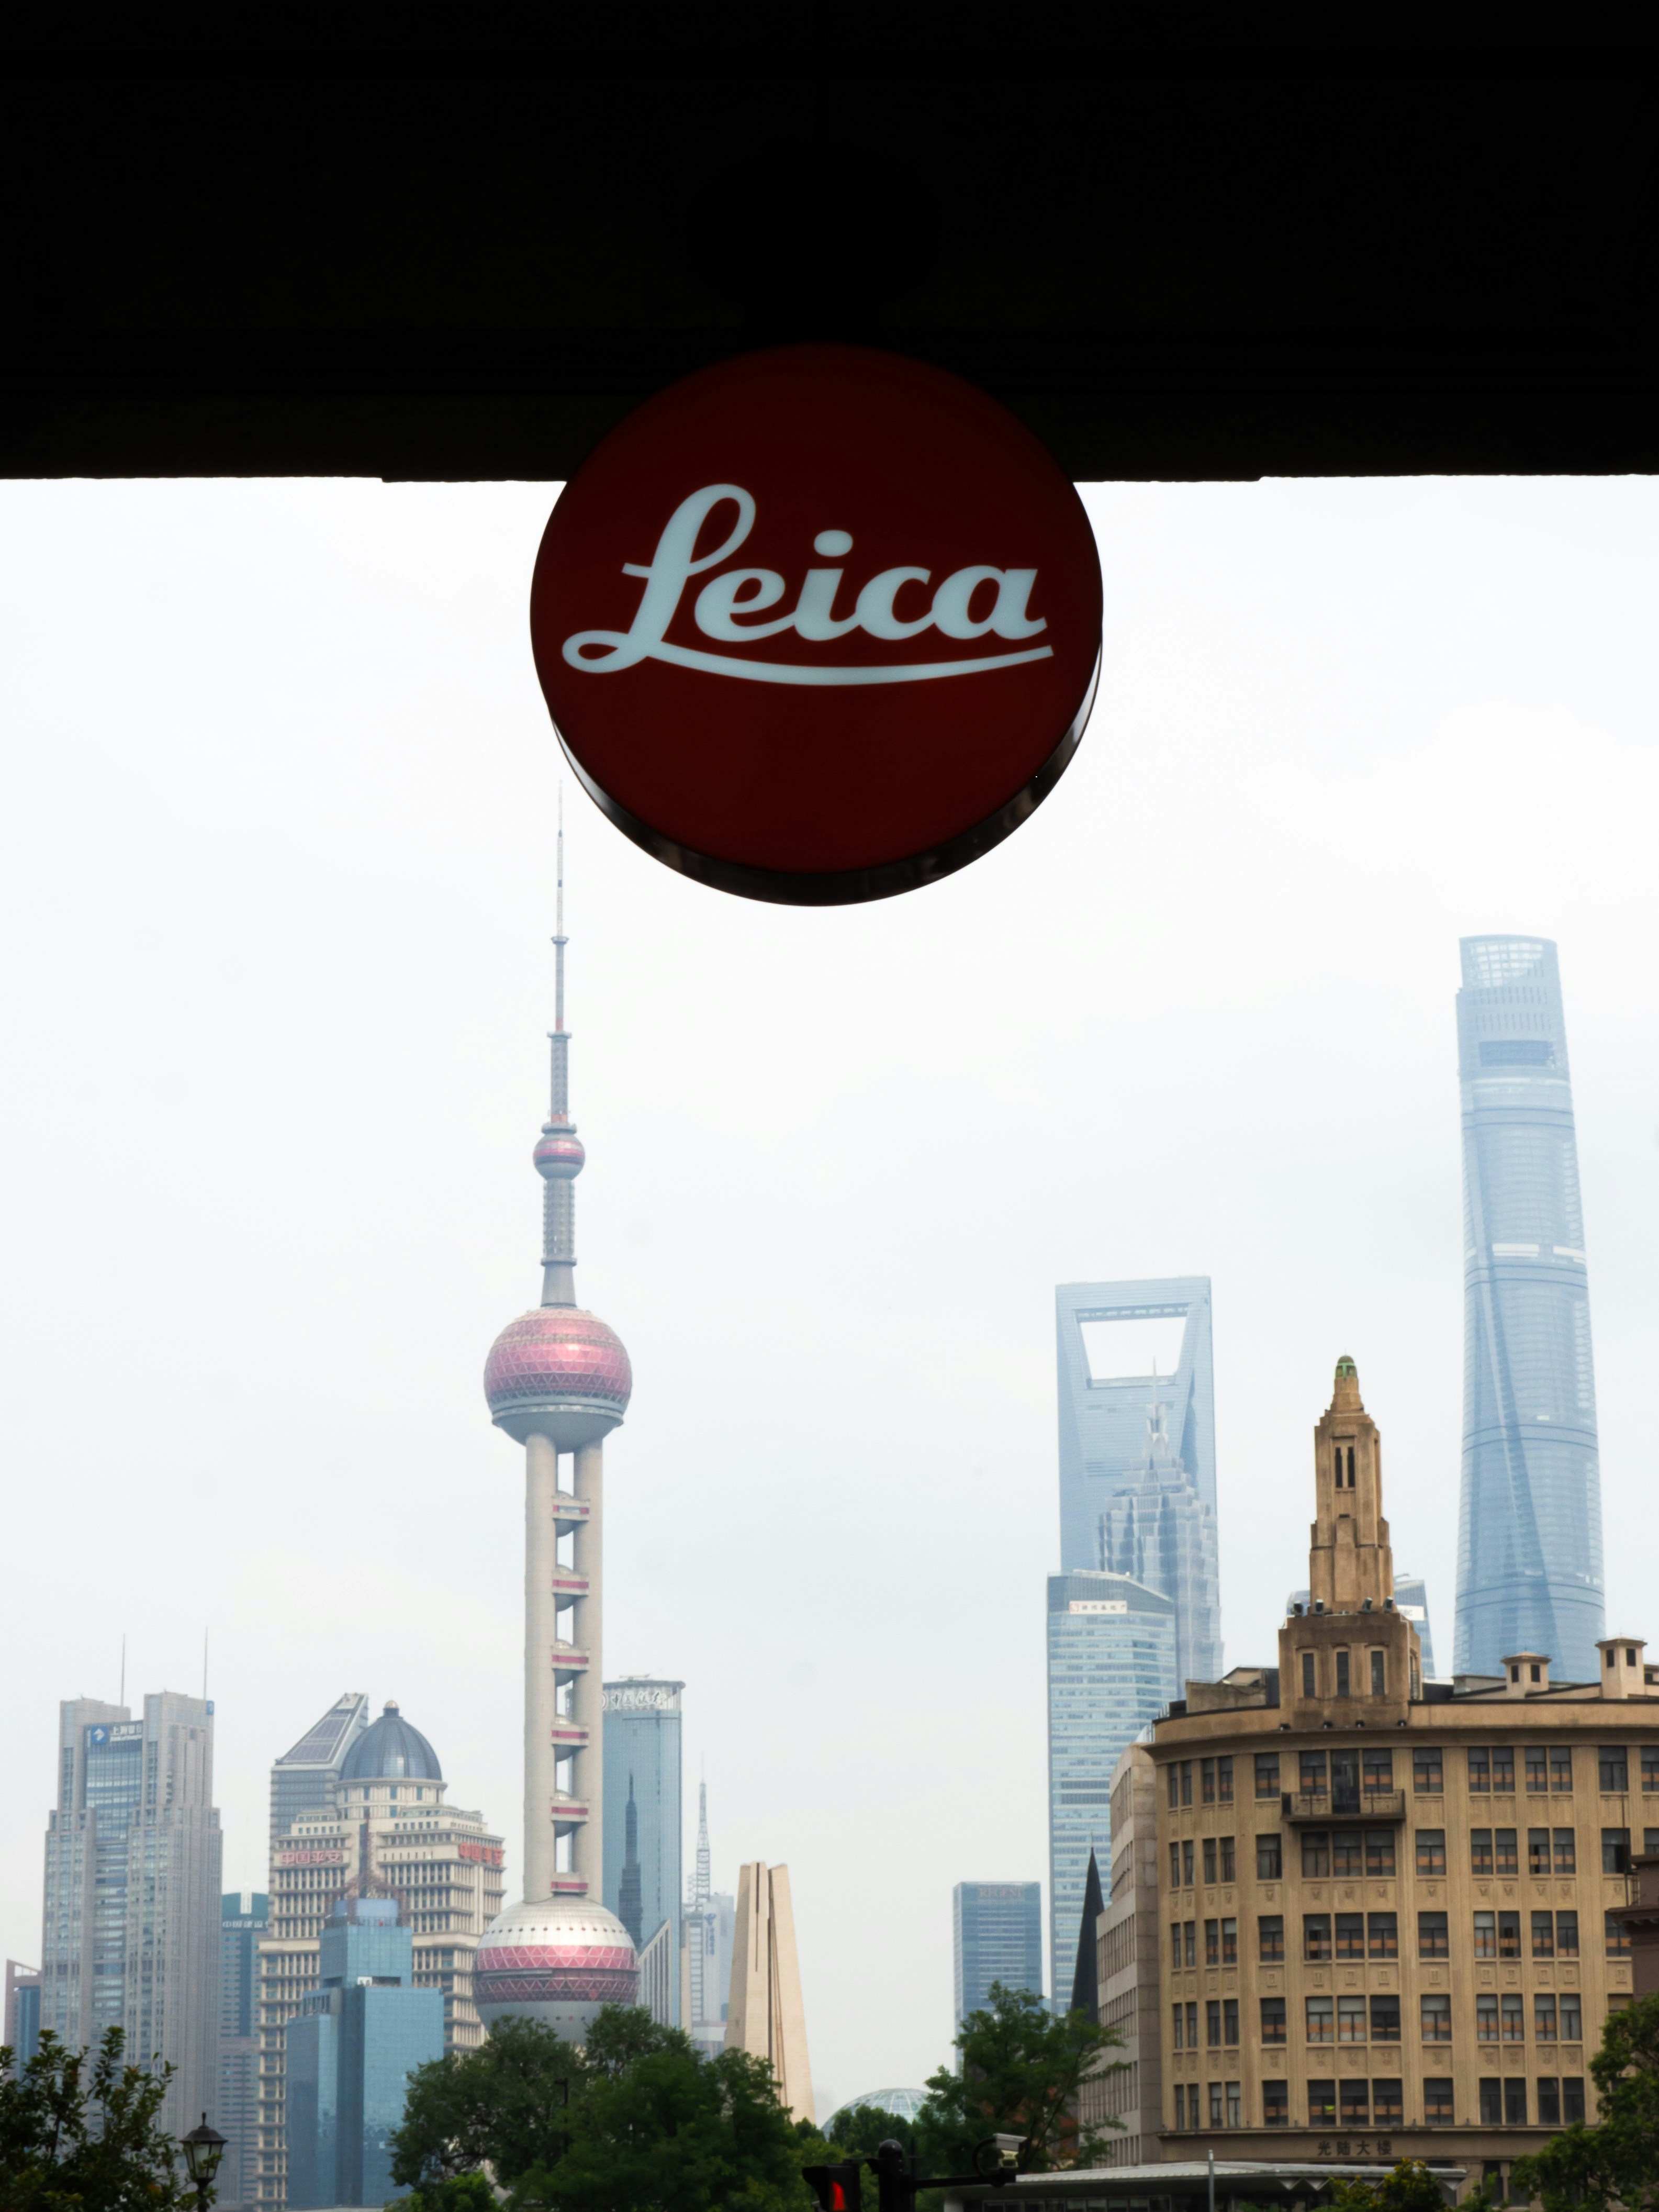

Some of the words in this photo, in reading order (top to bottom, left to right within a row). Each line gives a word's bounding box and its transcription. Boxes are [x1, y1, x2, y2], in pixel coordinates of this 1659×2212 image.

[562, 484, 1053, 685] Leica
[279, 1850, 343, 1865] 中国平安
[1318, 2140, 1392, 2156] 光陆大楼
